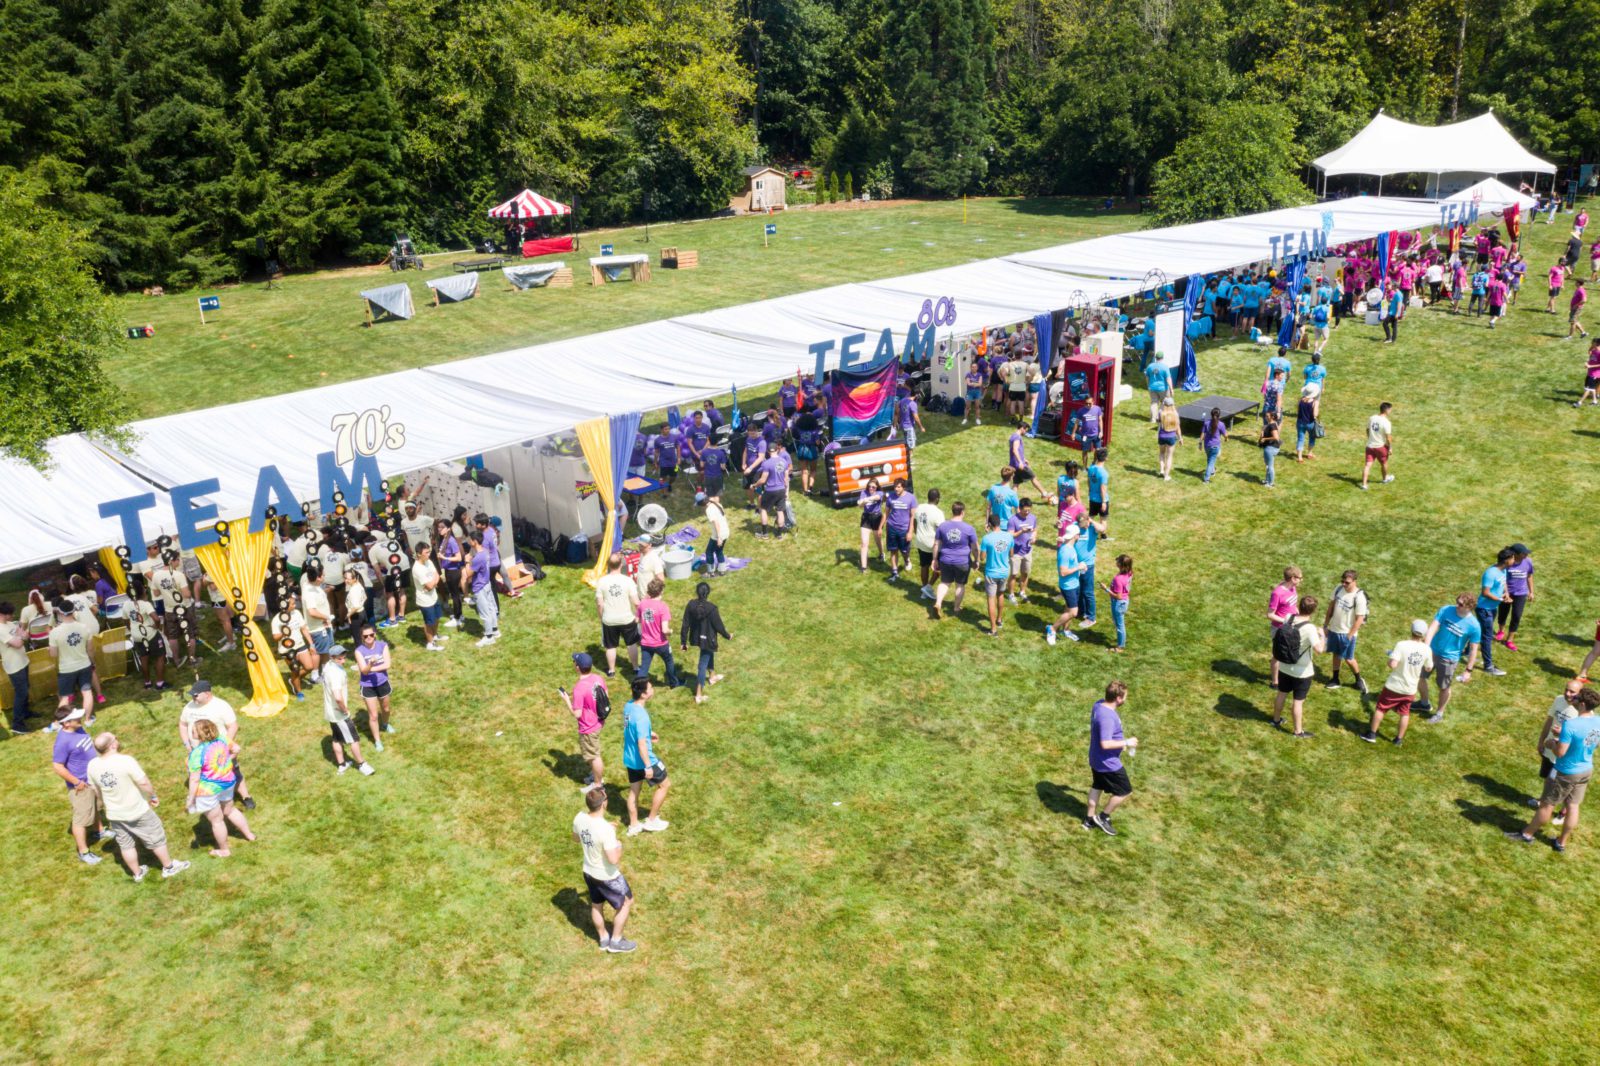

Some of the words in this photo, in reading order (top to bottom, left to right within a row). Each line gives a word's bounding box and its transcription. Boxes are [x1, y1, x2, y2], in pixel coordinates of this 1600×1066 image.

[1440, 200, 1479, 232] TEAM
[1269, 228, 1328, 266] TEAM
[917, 296, 957, 330] 80's
[808, 322, 937, 386] TEAM
[331, 404, 406, 466] 70's
[97, 450, 388, 564] TEAM
